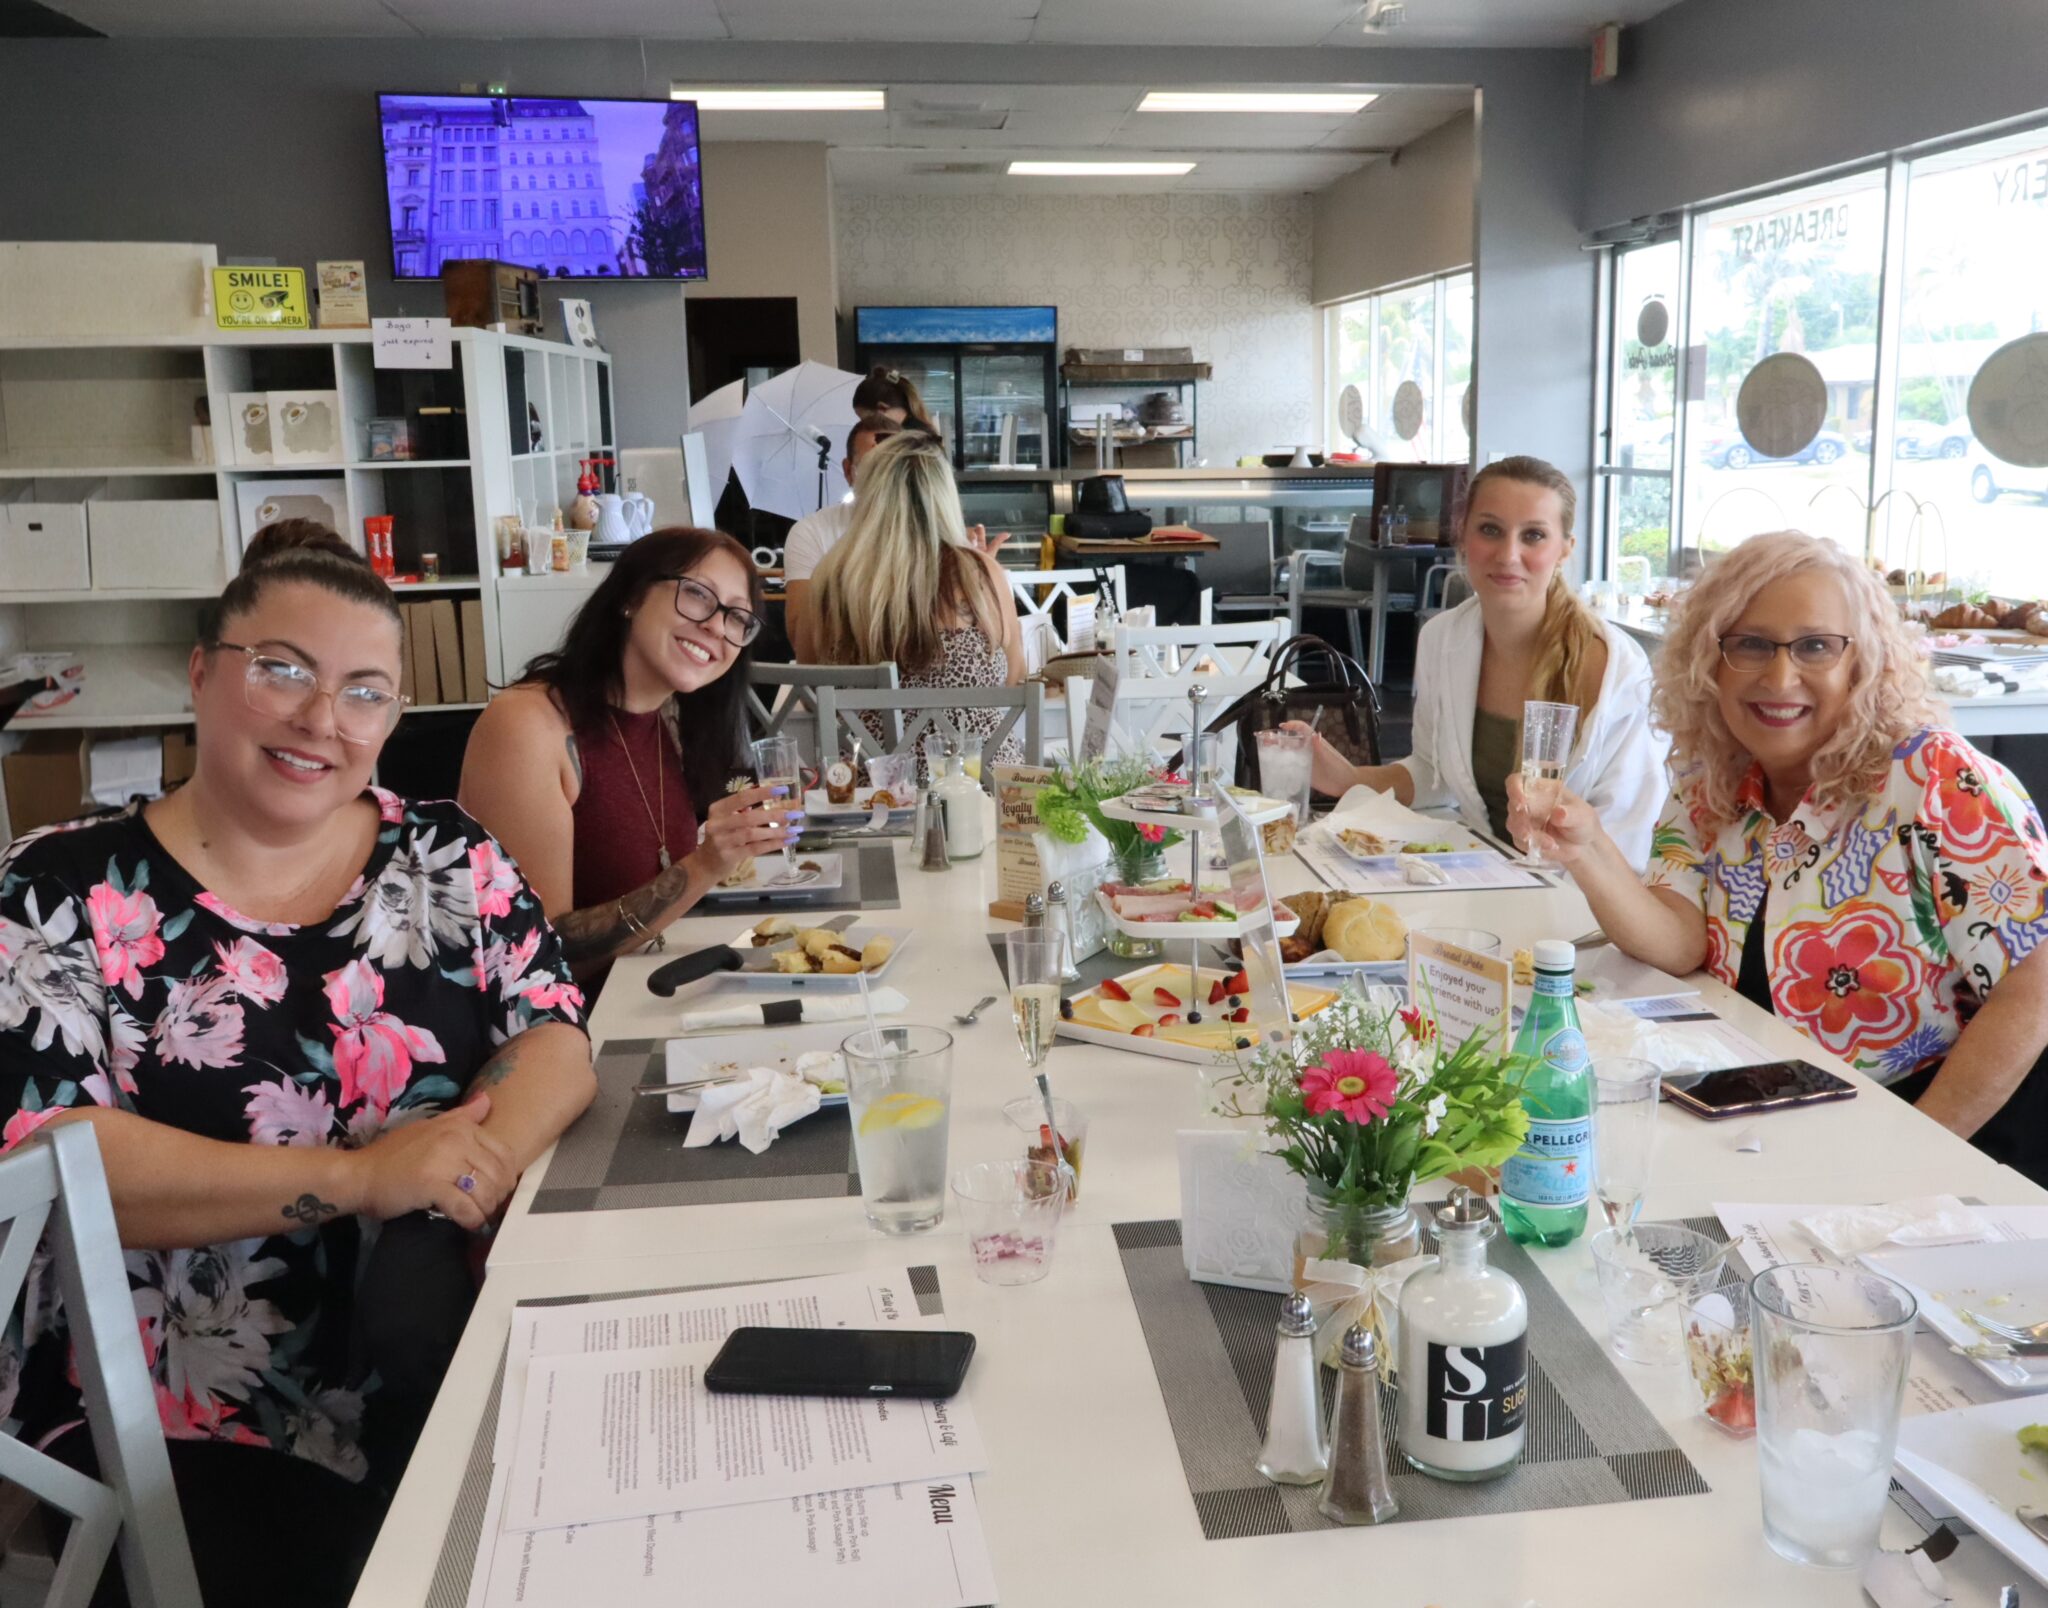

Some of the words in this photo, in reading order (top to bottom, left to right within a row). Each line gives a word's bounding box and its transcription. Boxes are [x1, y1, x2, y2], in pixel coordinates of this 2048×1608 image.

[229, 273, 289, 287] SMILE!
[222, 316, 251, 325] YOU'RE
[255, 316, 268, 325] ON
[1011, 772, 1035, 783] Bread
[1001, 802, 1032, 817] Loyalty
[1016, 813, 1041, 825] Memb
[1429, 964, 1464, 986] Enjoyed
[1465, 980, 1487, 995] your
[1417, 980, 1461, 1003] exerience
[1463, 996, 1483, 1011] with
[1484, 1006, 1501, 1017] us?
[876, 1399, 889, 1421] Foodies
[939, 1432, 958, 1447] Café
[854, 1488, 864, 1499] Egg
[856, 1500, 866, 1516] Sunny
[928, 1484, 956, 1525] Menu
[806, 1514, 816, 1526] Pork
[832, 1510, 842, 1522] Pork
[860, 1516, 870, 1528] Side
[565, 1530, 576, 1544] Cake
[806, 1527, 819, 1553] Sausage)
[833, 1523, 844, 1547] Sausage
[849, 1535, 859, 1548] Pork
[521, 1553, 531, 1566] with
[642, 1542, 656, 1576] Doughnuts)
[835, 1547, 848, 1565] Patty)
[850, 1549, 862, 1562] Roll)
[515, 1566, 530, 1602] Mascarpone
